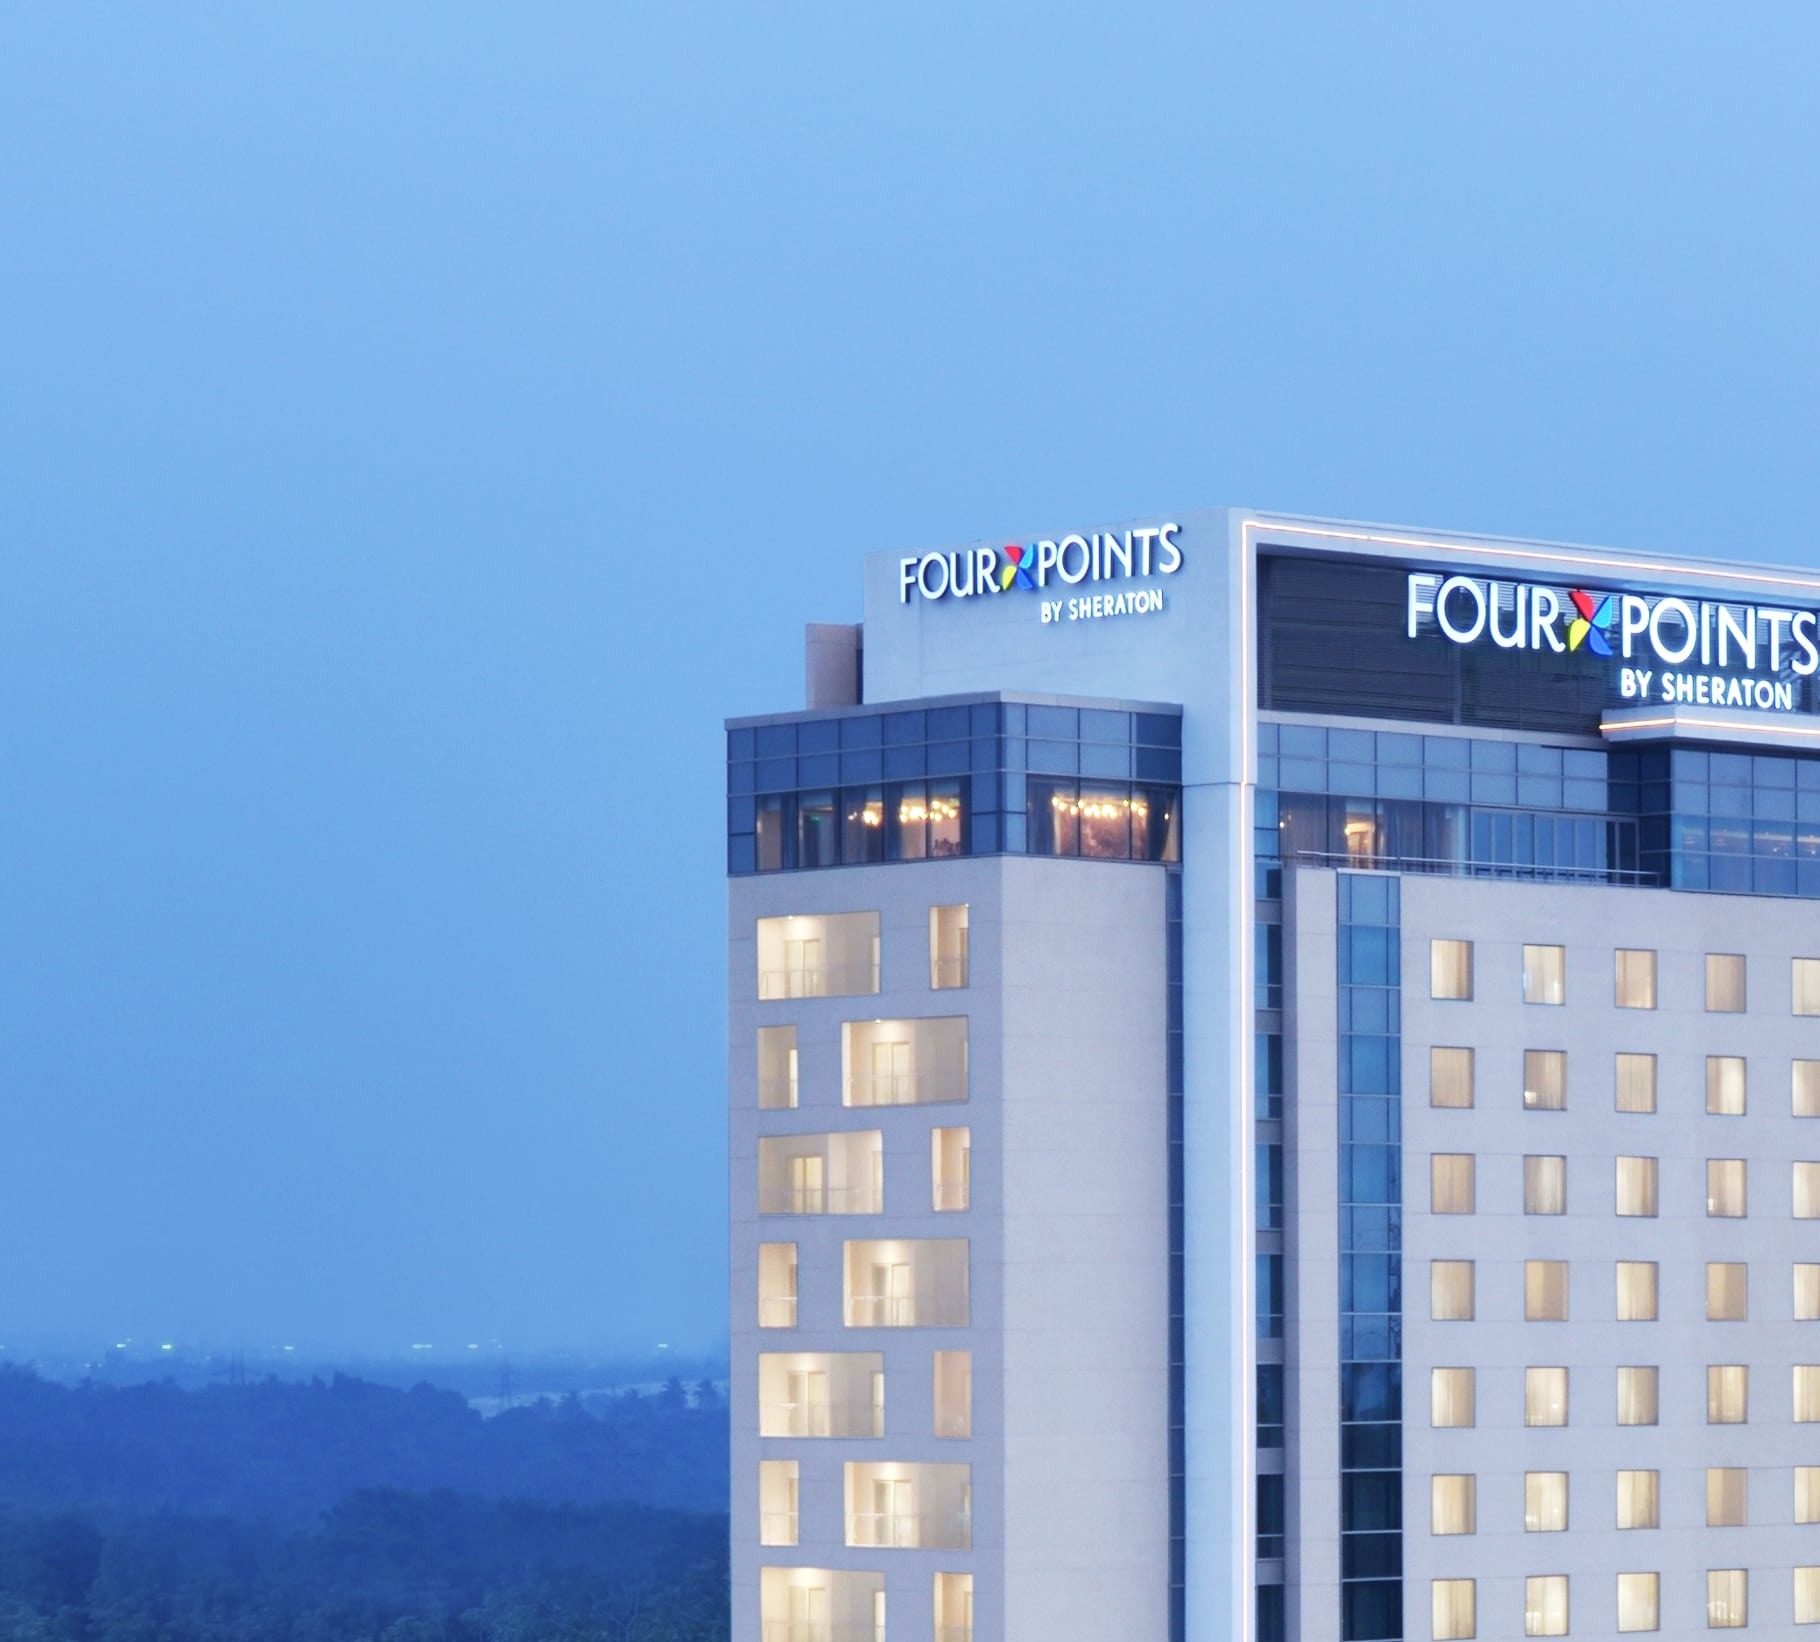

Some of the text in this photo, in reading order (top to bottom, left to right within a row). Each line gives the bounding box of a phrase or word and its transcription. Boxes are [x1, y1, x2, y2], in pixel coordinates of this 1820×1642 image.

[900, 523, 1182, 603] FOUR POINTS
[1041, 589, 1164, 623] BY SHERATON
[1408, 574, 1819, 676] FOUR POINTS
[1620, 668, 1793, 710] BY SHERATON
